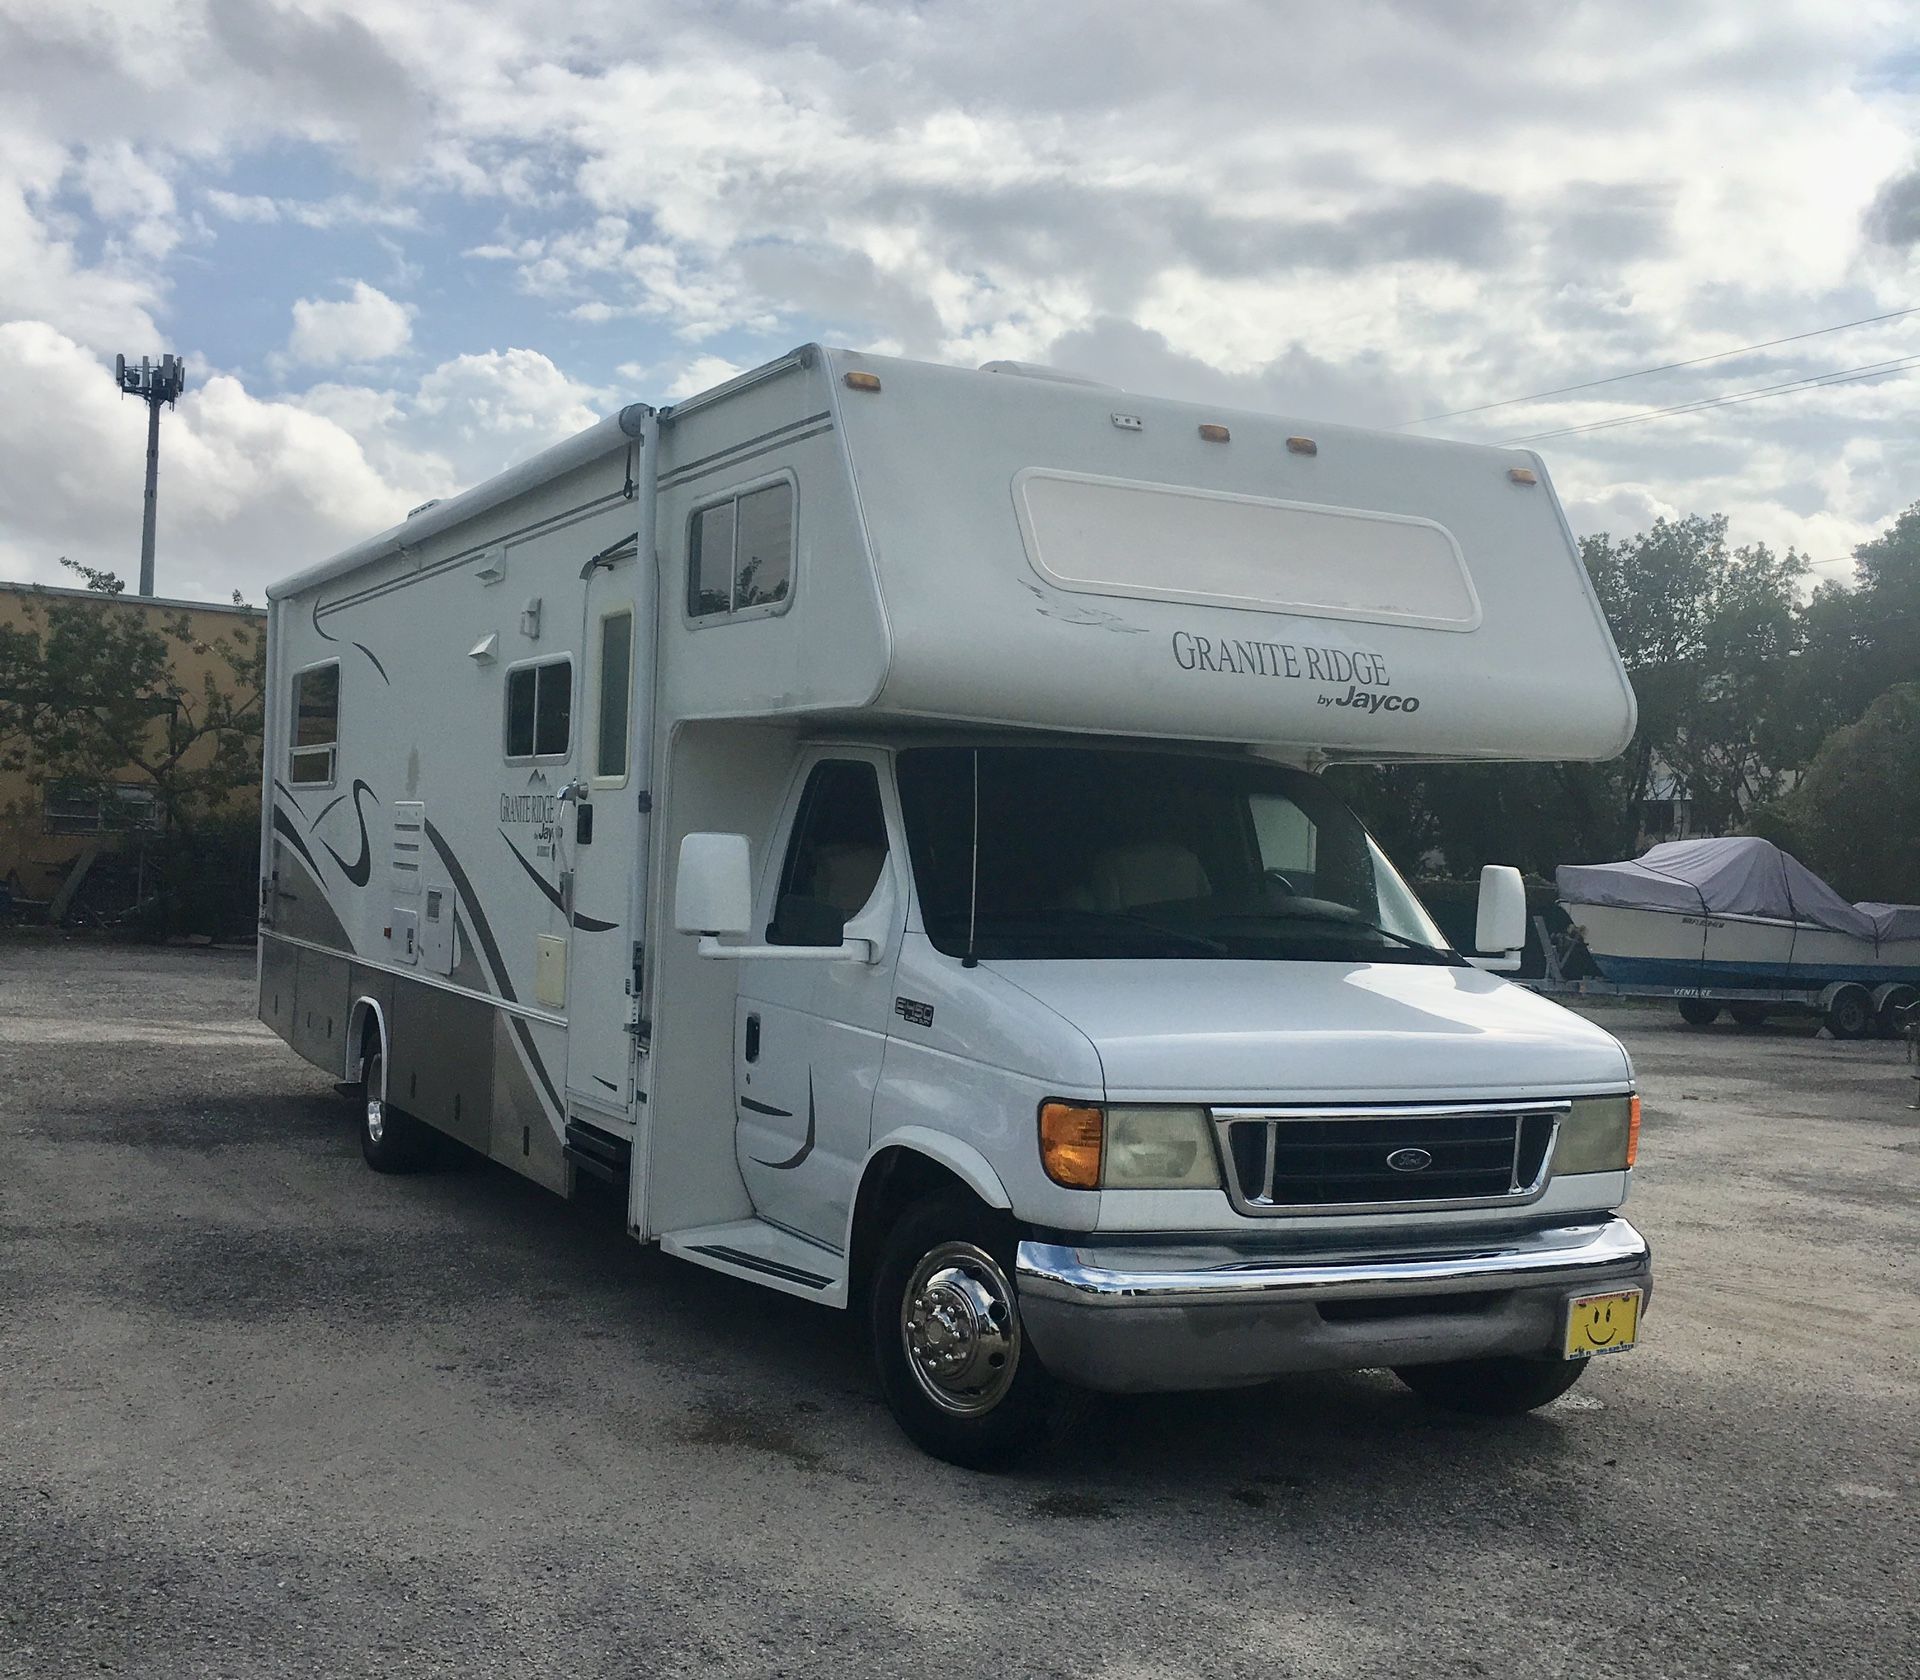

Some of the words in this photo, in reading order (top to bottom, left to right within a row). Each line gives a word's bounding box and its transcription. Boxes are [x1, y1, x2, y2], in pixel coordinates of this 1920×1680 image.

[1172, 630, 1300, 678] GRANITE
[1302, 646, 1390, 687] RIDGE
[1316, 693, 1334, 707] by
[1335, 685, 1420, 714] Jayco
[500, 792, 530, 823] GRANITE
[531, 795, 555, 823] RIDGE
[538, 822, 563, 843] Jayo
